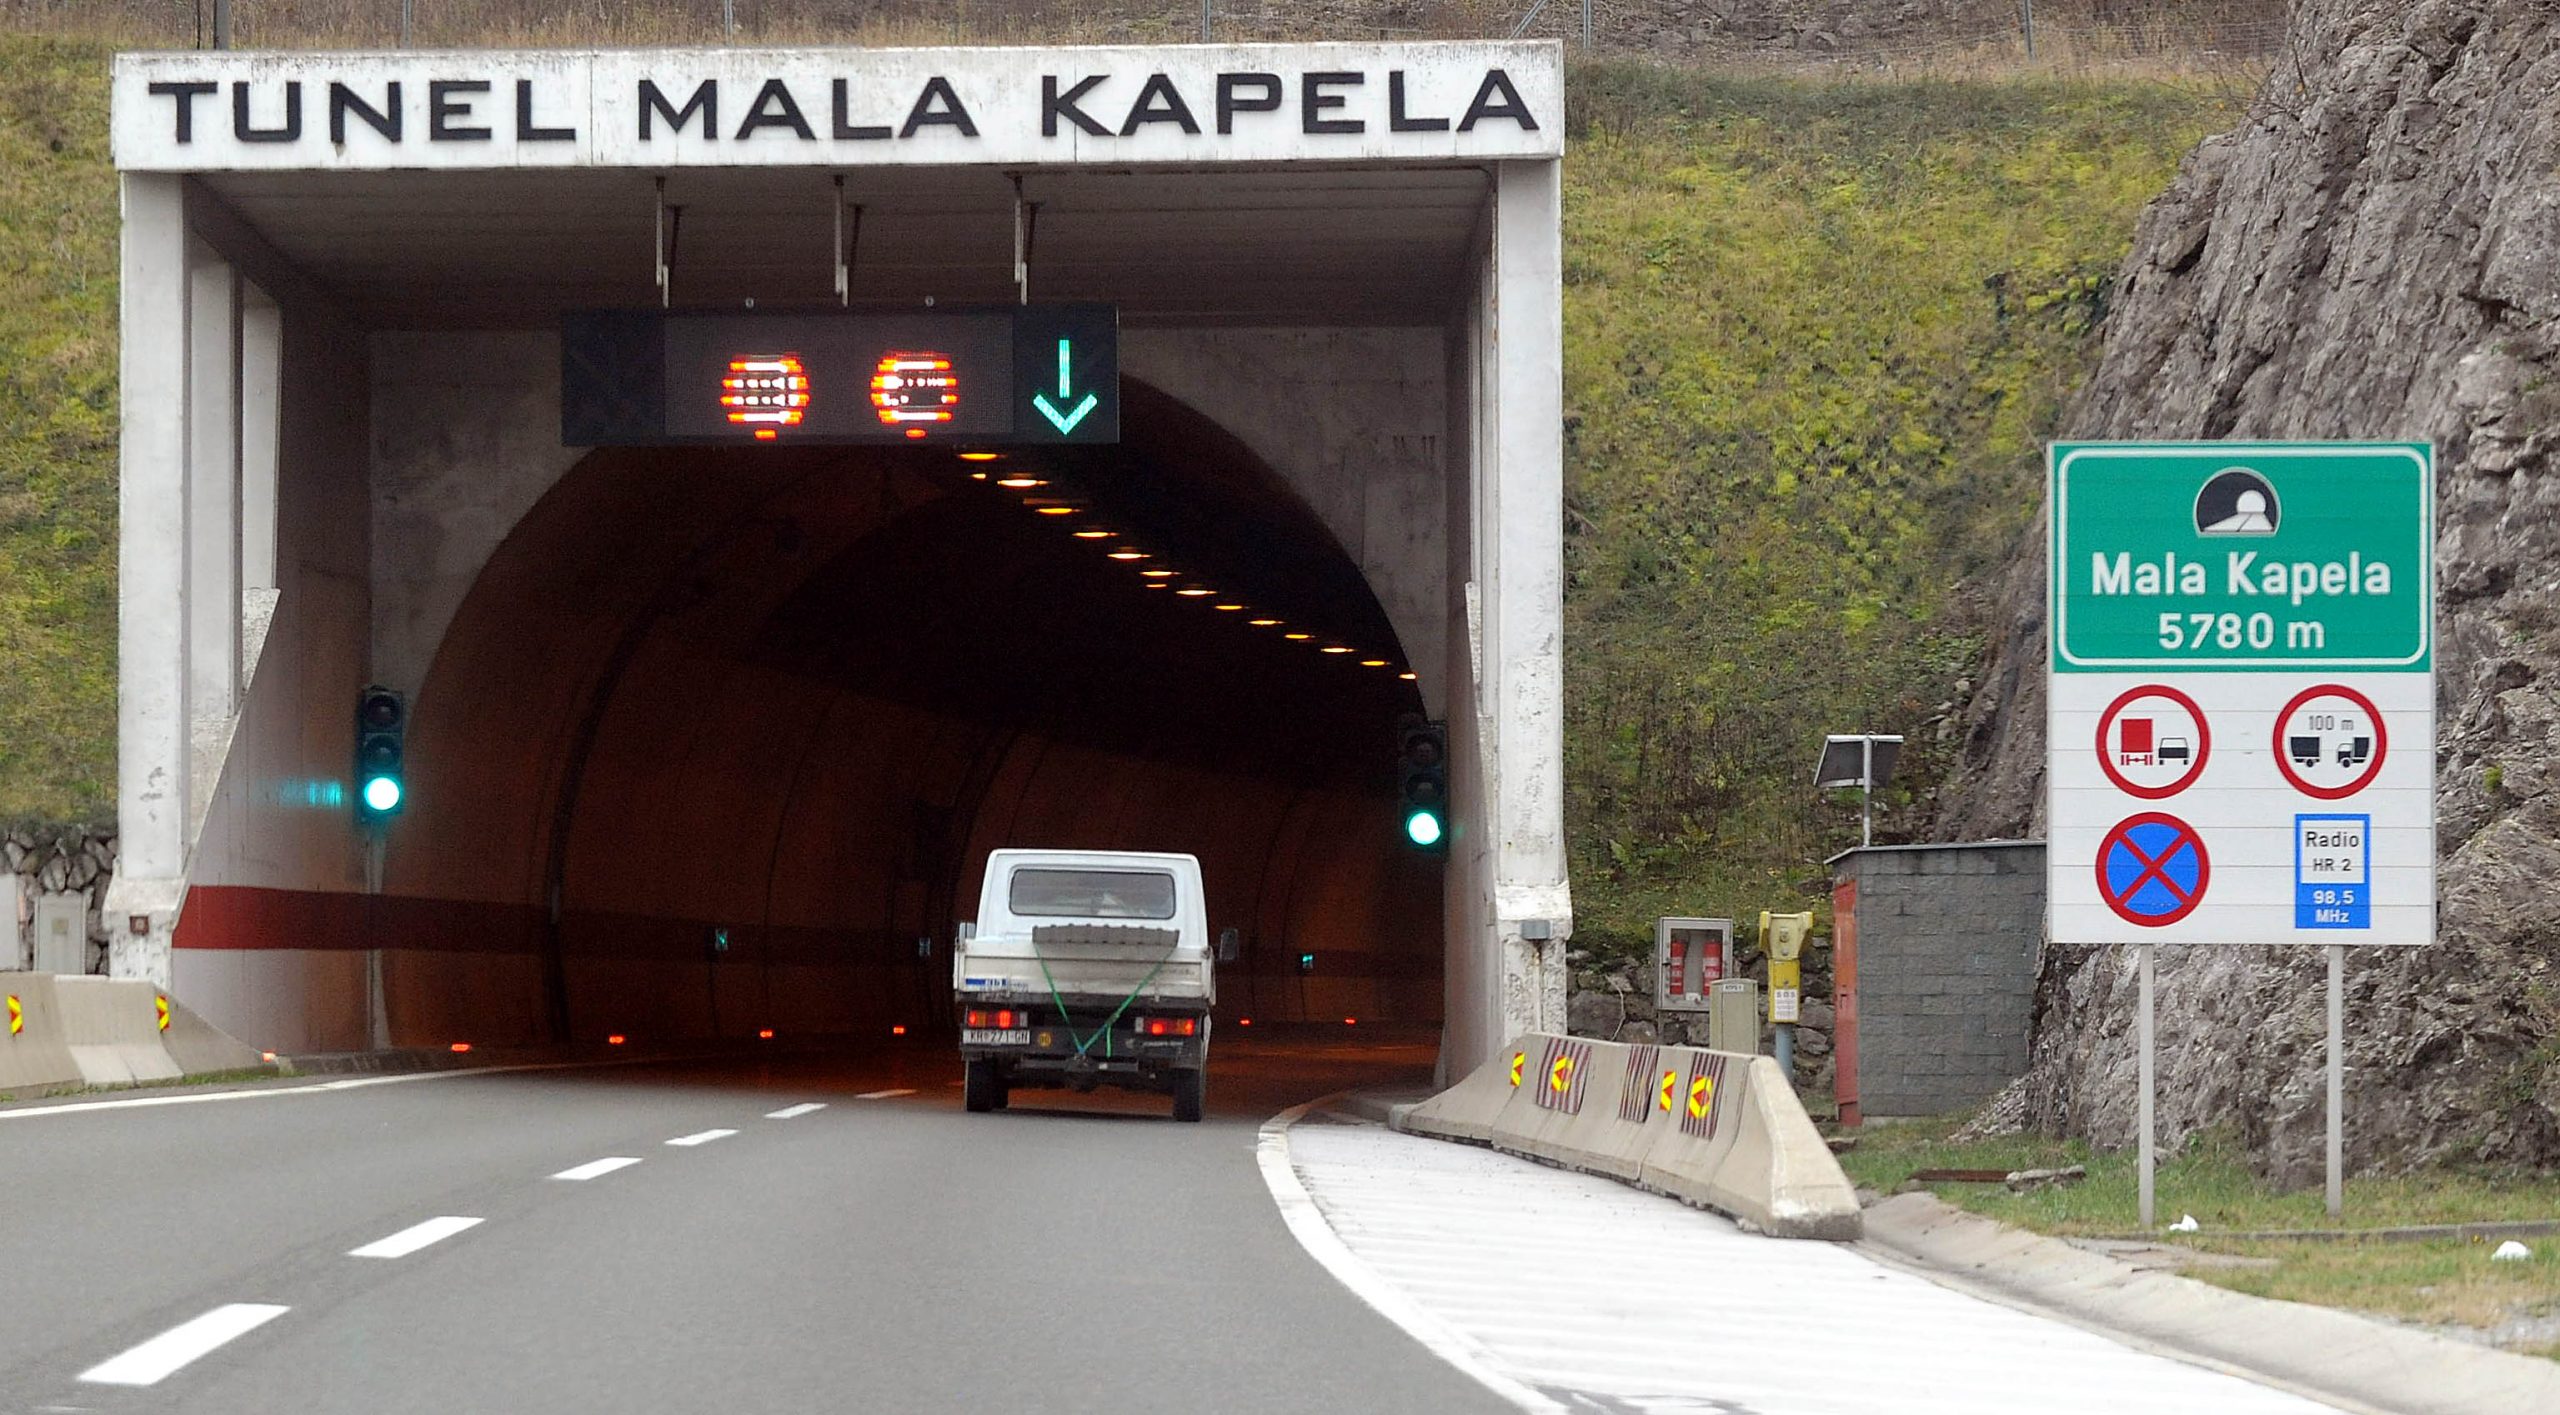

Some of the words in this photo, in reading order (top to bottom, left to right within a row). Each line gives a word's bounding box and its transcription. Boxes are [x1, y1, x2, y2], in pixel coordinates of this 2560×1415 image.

[148, 80, 577, 144] TUNEL
[638, 77, 980, 141] MALA
[1041, 70, 1541, 138] KAPELA
[2092, 551, 2207, 595] Mala
[2228, 551, 2391, 606] Kapela
[2159, 612, 2274, 650] 5780
[2287, 621, 2325, 649] m
[2308, 715, 2335, 731] 100
[2341, 719, 2354, 731] m
[2305, 831, 2360, 848] Radio
[2313, 858, 2335, 872] HR
[2341, 858, 2352, 872] 2
[2313, 890, 2354, 906] 98,5
[2315, 909, 2350, 924] MHz
